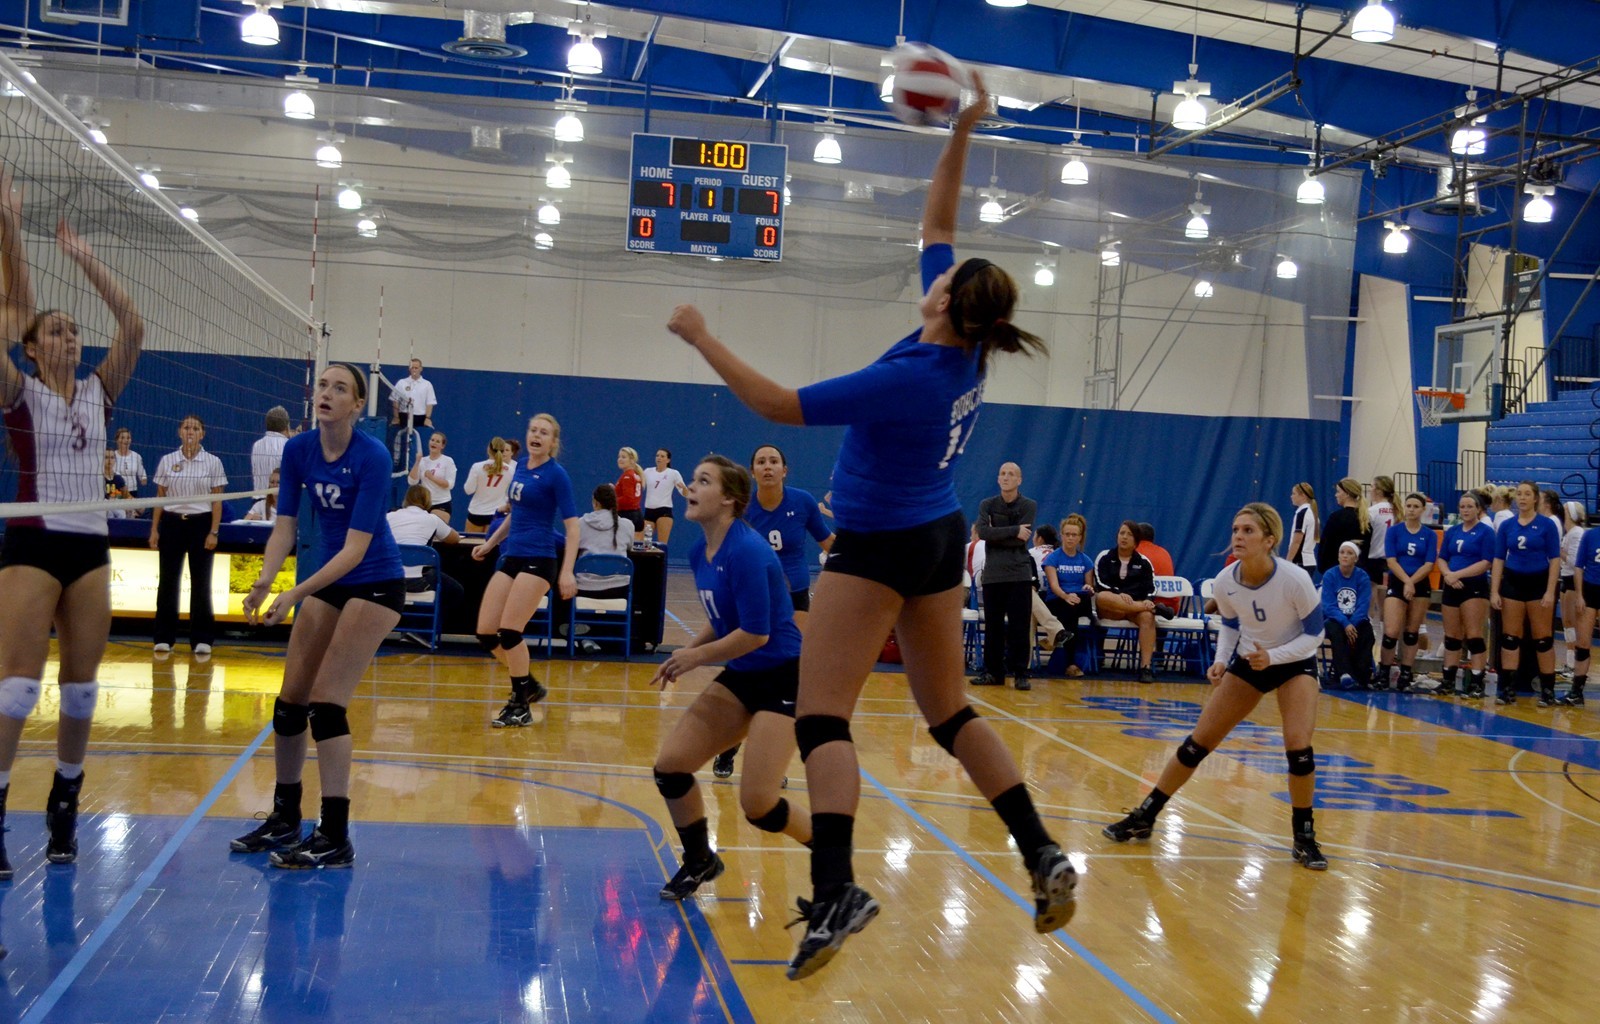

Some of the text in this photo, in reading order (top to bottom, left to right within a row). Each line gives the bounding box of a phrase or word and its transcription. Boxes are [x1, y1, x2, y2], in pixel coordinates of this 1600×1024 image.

[700, 143, 745, 168] 1:00
[640, 166, 673, 180] HOME
[694, 177, 722, 187] PERIOD
[742, 175, 779, 188] GUEST
[662, 183, 674, 206] 7
[707, 190, 713, 207] 1
[766, 191, 779, 214] 7
[631, 208, 656, 217] FOULS
[680, 212, 732, 223] PLAYER FOUL
[639, 217, 652, 237] 0
[755, 217, 780, 227] FOULS
[763, 227, 775, 246] 0
[629, 240, 655, 250] SCORE
[690, 244, 718, 254] MATCH
[753, 249, 779, 259] SCORE
[486, 474, 503, 487] 17
[315, 482, 345, 509] 12
[510, 481, 524, 501] 13
[768, 529, 783, 551] 9
[1456, 539, 1464, 553] 7
[1517, 535, 1527, 550] 2
[1407, 542, 1417, 556] 5
[1155, 580, 1183, 592] PERU
[1252, 600, 1267, 622] 6
